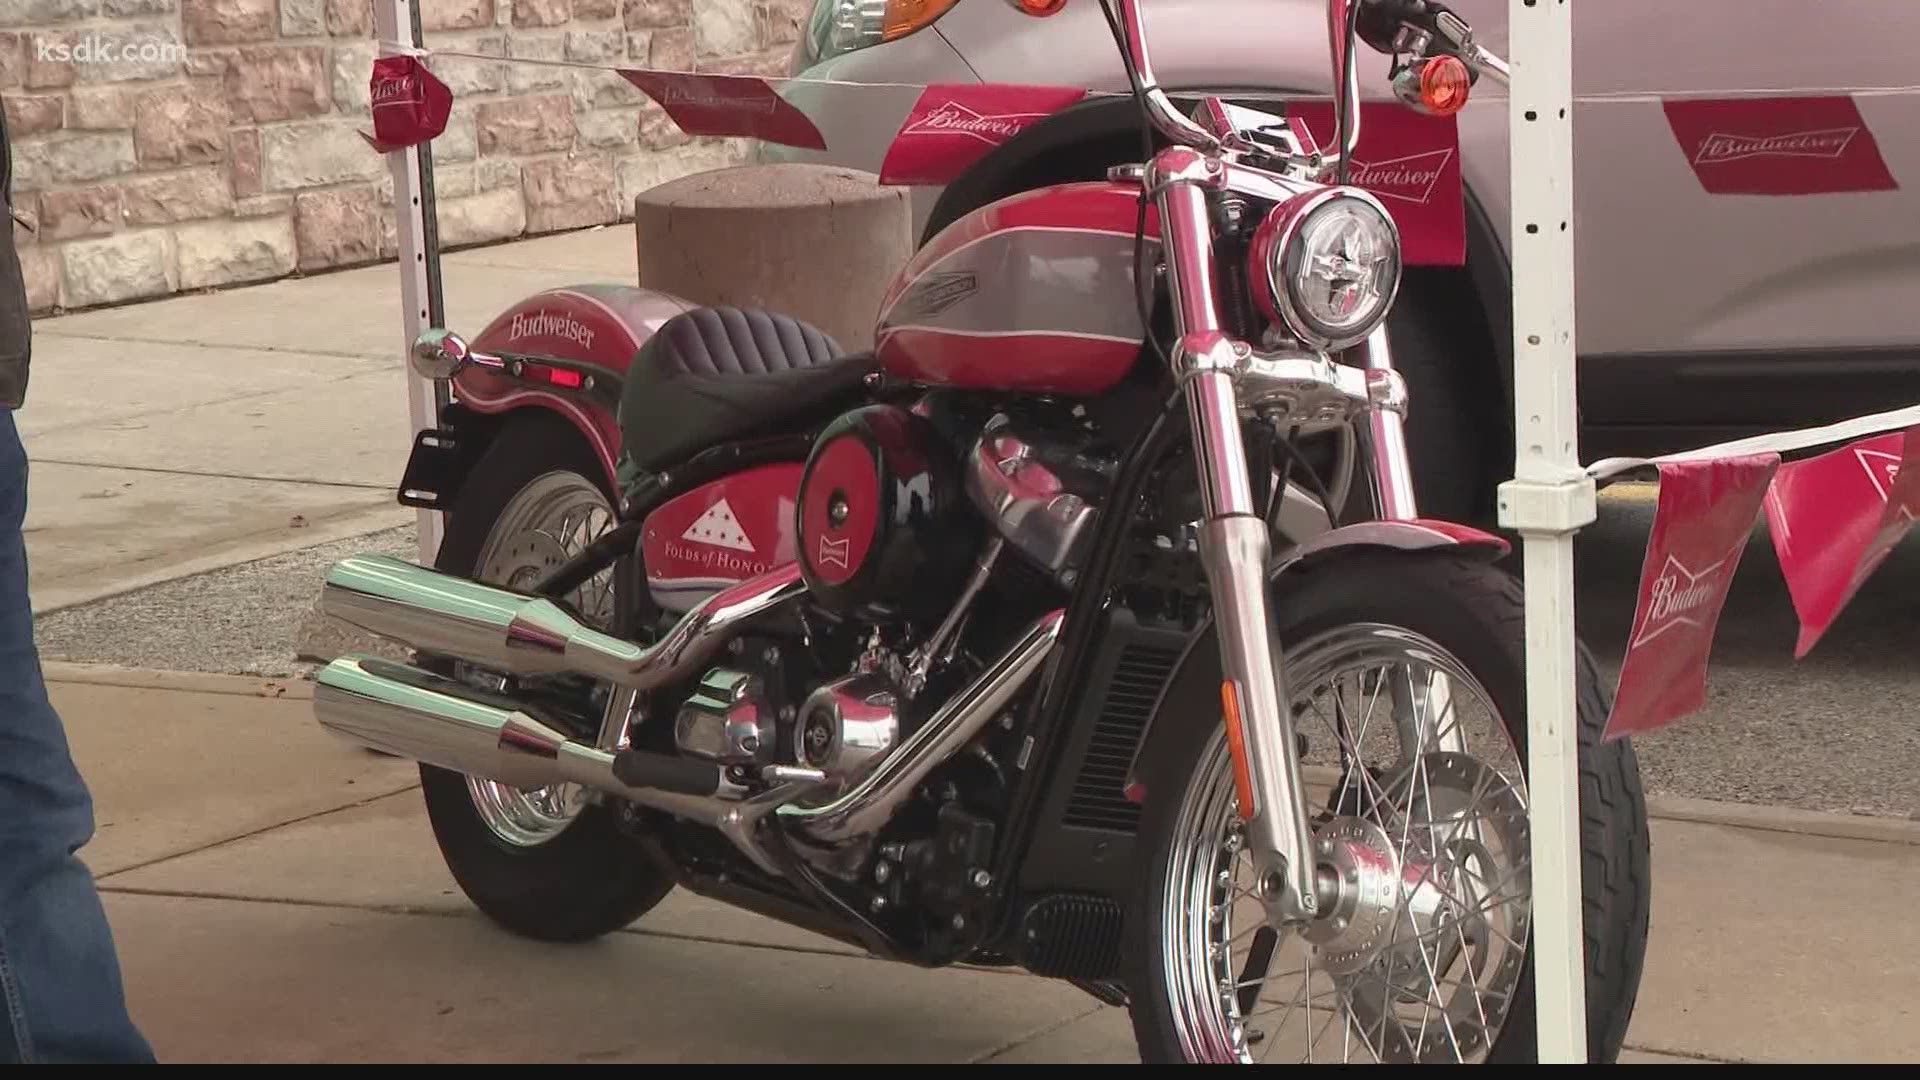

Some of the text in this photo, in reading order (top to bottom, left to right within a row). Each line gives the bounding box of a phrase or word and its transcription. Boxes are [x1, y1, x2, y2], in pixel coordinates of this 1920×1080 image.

[927, 107, 1022, 137] Budweis
[509, 308, 595, 350] Budweiser
[717, 551, 774, 575] HONO
